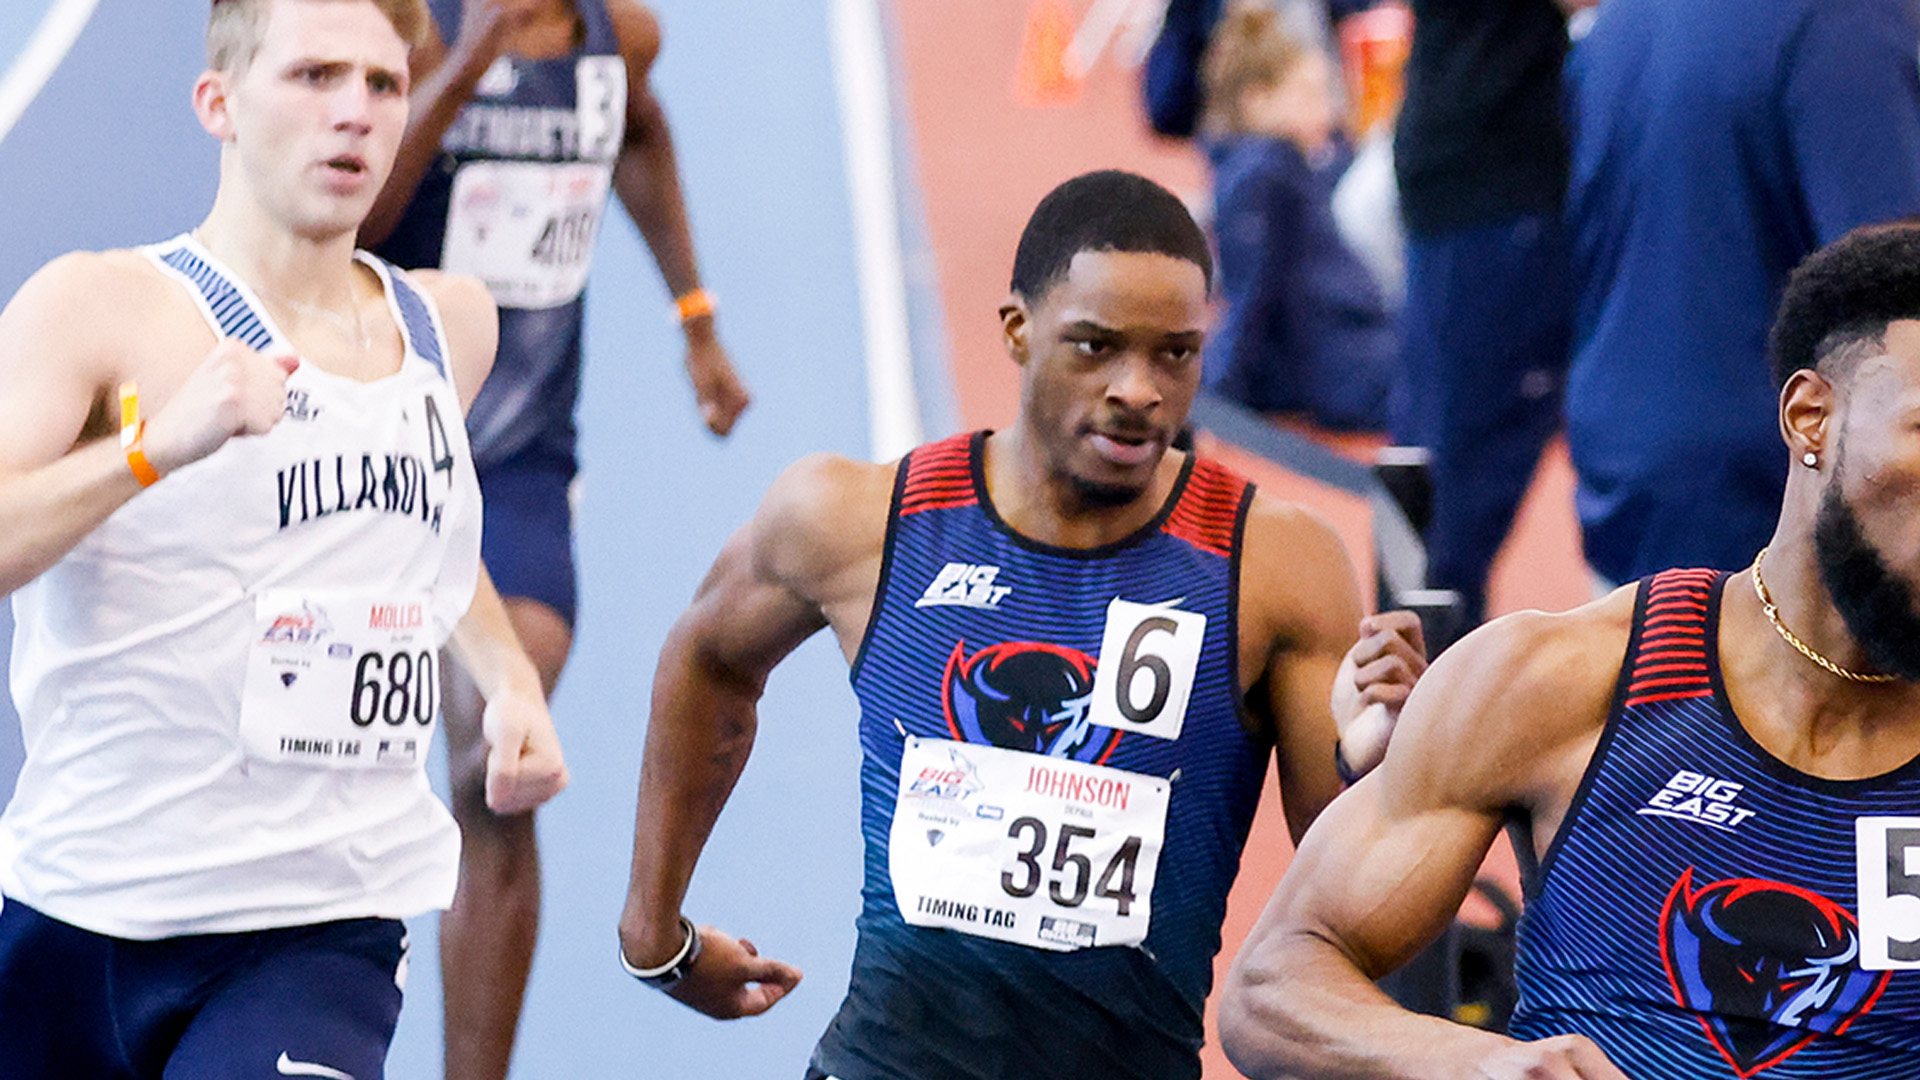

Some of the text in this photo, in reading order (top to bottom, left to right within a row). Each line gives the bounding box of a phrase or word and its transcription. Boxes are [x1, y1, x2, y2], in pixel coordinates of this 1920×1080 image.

[425, 395, 455, 490] 4
[350, 650, 434, 727] 680
[1115, 616, 1178, 724] 6
[280, 738, 332, 755] TIMING
[337, 739, 361, 756] TAG
[1024, 766, 1131, 810] JOHNSON
[1648, 787, 1756, 827] EAST
[1665, 769, 1744, 803] BIG
[1001, 816, 1143, 917] 354
[917, 896, 1017, 929] TIMING TAG
